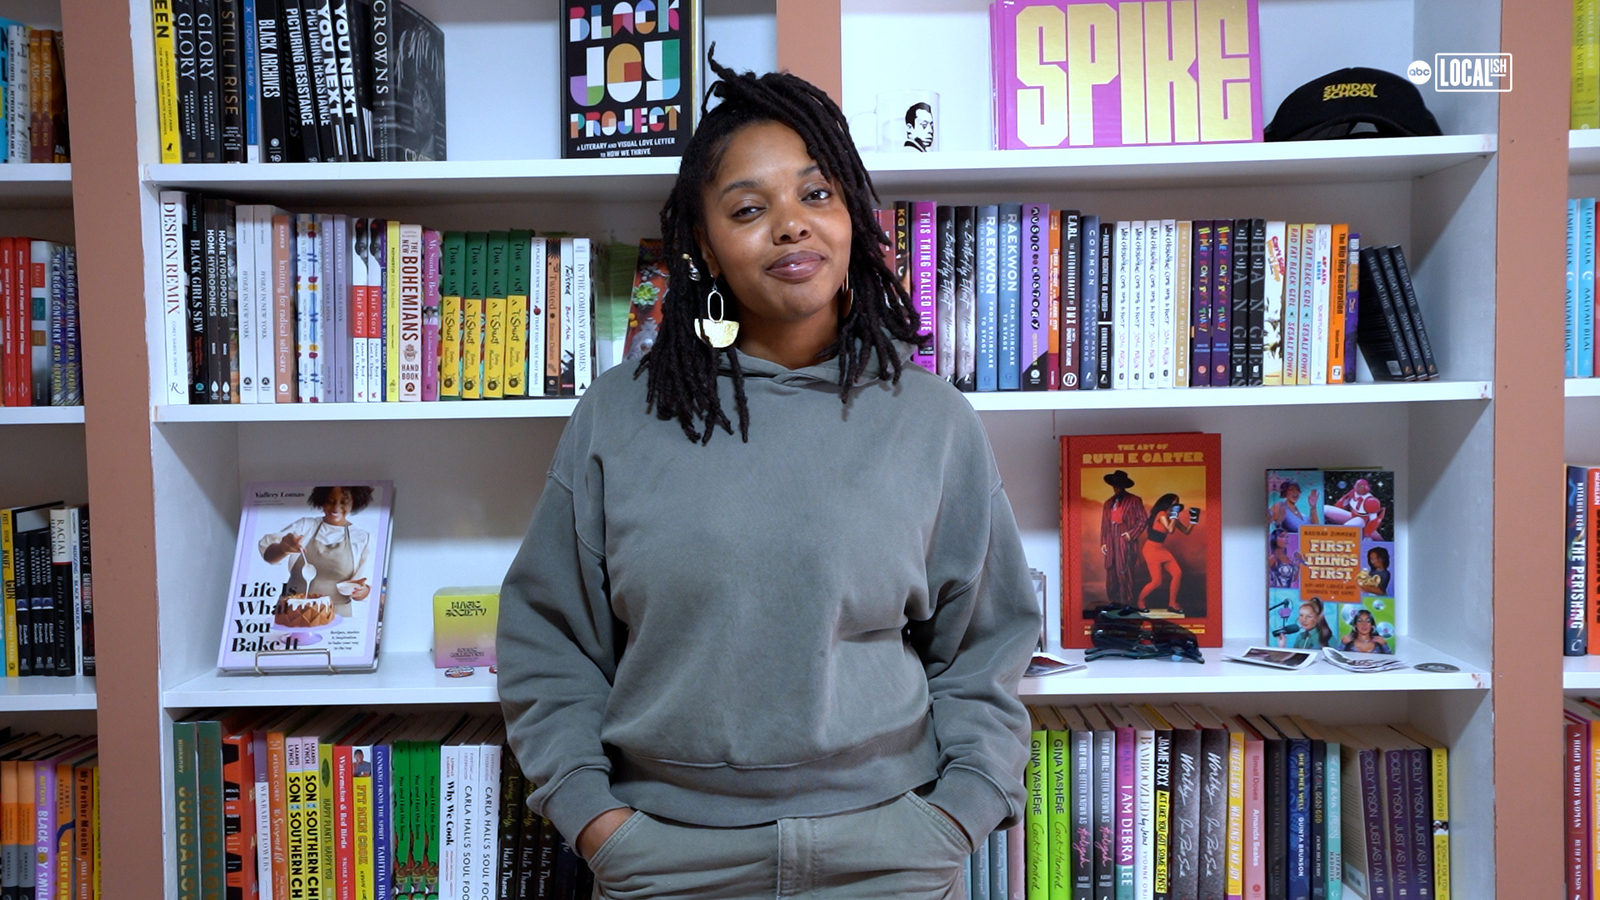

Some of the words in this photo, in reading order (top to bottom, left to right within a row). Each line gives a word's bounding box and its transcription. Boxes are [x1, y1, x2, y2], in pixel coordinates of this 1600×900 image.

[222, 10, 236, 57] STILL
[258, 19, 277, 50] BLACK
[318, 4, 334, 52] YOU
[334, 3, 350, 52] YOU
[570, 0, 681, 42] BLACK
[1576, 15, 1585, 50] WOMEN
[178, 13, 195, 81] GLORY
[197, 13, 215, 81] GLORY
[286, 8, 306, 63] PICTURING
[372, 0, 389, 94] CROWNS
[261, 53, 280, 98] ARCHIVES
[570, 39, 681, 107] JOY
[1015, 0, 1253, 148] SPIKE
[1576, 52, 1585, 93] WRITERS
[224, 76, 239, 117] RISE
[294, 64, 314, 126] RESISTANCE
[324, 58, 341, 118] NEXT
[340, 58, 357, 118] NEXT
[1322, 90, 1378, 102] SCHOOL
[1324, 83, 1377, 94] SUNDAY
[570, 105, 681, 138] PROJECT
[581, 142, 607, 151] LITERARY
[617, 140, 638, 148] VISUAL
[638, 138, 653, 147] LOVE
[654, 137, 675, 145] LETTER
[163, 201, 178, 259] DESIGN
[919, 212, 931, 234] THIS
[1067, 215, 1077, 241] EARL
[207, 229, 215, 254] HOME
[218, 230, 226, 255] HOME
[919, 238, 931, 267] THING
[986, 216, 996, 294] RAEKWON
[1007, 213, 1017, 291] RAEKWON
[1584, 242, 1592, 265] FOLK
[190, 239, 202, 274] BLACK
[577, 263, 585, 272] IN
[1088, 230, 1096, 285] COMMON
[1367, 256, 1376, 269] SHE
[166, 264, 180, 315] REMIX
[207, 256, 217, 317] HYDROPONICS
[219, 256, 228, 317] HYDROPONICS
[278, 259, 288, 294] knitting
[577, 273, 585, 290] THE
[920, 271, 931, 307] CALLED
[1371, 271, 1383, 293] BEGAT
[191, 277, 203, 308] GIRLS
[279, 295, 288, 308] for
[356, 289, 364, 310] Hair
[402, 256, 419, 341] BOHEMIANS
[548, 275, 557, 310] Twisted
[1380, 293, 1390, 309] THIS
[192, 310, 204, 333] SEW
[279, 309, 288, 337] radical
[355, 312, 364, 335] Story
[577, 292, 585, 327] COMPANY
[920, 311, 931, 331] LIFE
[1387, 314, 1397, 332] JOAN
[578, 329, 586, 339] OF
[1393, 333, 1407, 360] MORGAN
[1583, 328, 1591, 352] BILAL
[280, 339, 289, 373] self-care
[578, 341, 586, 372] WOMEN
[402, 373, 419, 381] BOOK
[1082, 453, 1124, 464] RUTH
[1128, 453, 1138, 463] E
[1142, 452, 1204, 463] CARTER
[57, 519, 66, 556] RACIAL
[82, 519, 90, 552] STATE
[1309, 540, 1356, 553] FIRST
[83, 556, 90, 565] of
[1304, 553, 1359, 567] THINGS
[1572, 539, 1586, 561] THE
[1308, 567, 1354, 580] FIRST
[82, 573, 92, 614] EMERGENCY
[240, 582, 277, 597] Life
[280, 583, 298, 597] Is
[1570, 565, 1585, 629] PERISHING
[237, 600, 290, 616] What
[234, 619, 271, 634] You
[230, 637, 280, 652] Bake
[285, 637, 299, 651] It
[1030, 740, 1041, 768] GINA
[1053, 738, 1064, 767] GINA
[1157, 736, 1169, 762] JAMIE
[1231, 738, 1241, 772] JENIFER
[1573, 739, 1582, 762] RIGHT
[79, 771, 88, 783] My
[1157, 763, 1169, 787] FOXX
[1178, 753, 1195, 806] Worthy
[1205, 752, 1222, 806] Worthy
[1230, 772, 1241, 798] LEWIS
[1573, 765, 1582, 797] WORTHY
[80, 785, 89, 818] Brother
[289, 776, 301, 803] SON
[445, 781, 455, 803] Why
[464, 785, 472, 814] CARLA
[1032, 770, 1042, 816] YASHERE
[1054, 769, 1065, 814] YASHERE
[1122, 792, 1133, 814] AM
[1159, 792, 1168, 803] ACT
[260, 785, 268, 831] WEARABLE
[446, 804, 454, 819] We
[1158, 804, 1167, 818] LIKE
[1574, 799, 1582, 828] WOMAN
[446, 821, 454, 846] Cook
[1157, 819, 1167, 832] YOU
[1230, 805, 1241, 841] WALKING
[80, 820, 89, 856] Moochie
[290, 811, 302, 876] SOUTHERN
[1121, 817, 1133, 862] DEBRA
[1157, 833, 1166, 847] GOT
[1230, 842, 1241, 851] IN
[60, 851, 68, 878] LUCKY
[262, 833, 270, 872] FLOWERS
[463, 852, 471, 877] SOUL
[1031, 822, 1045, 891] Cack-Handed
[1157, 848, 1166, 867] SOME
[1230, 852, 1240, 864] MY
[1122, 865, 1133, 886] LEE
[1157, 868, 1166, 891] SENSE
[1230, 865, 1241, 882] JOY
